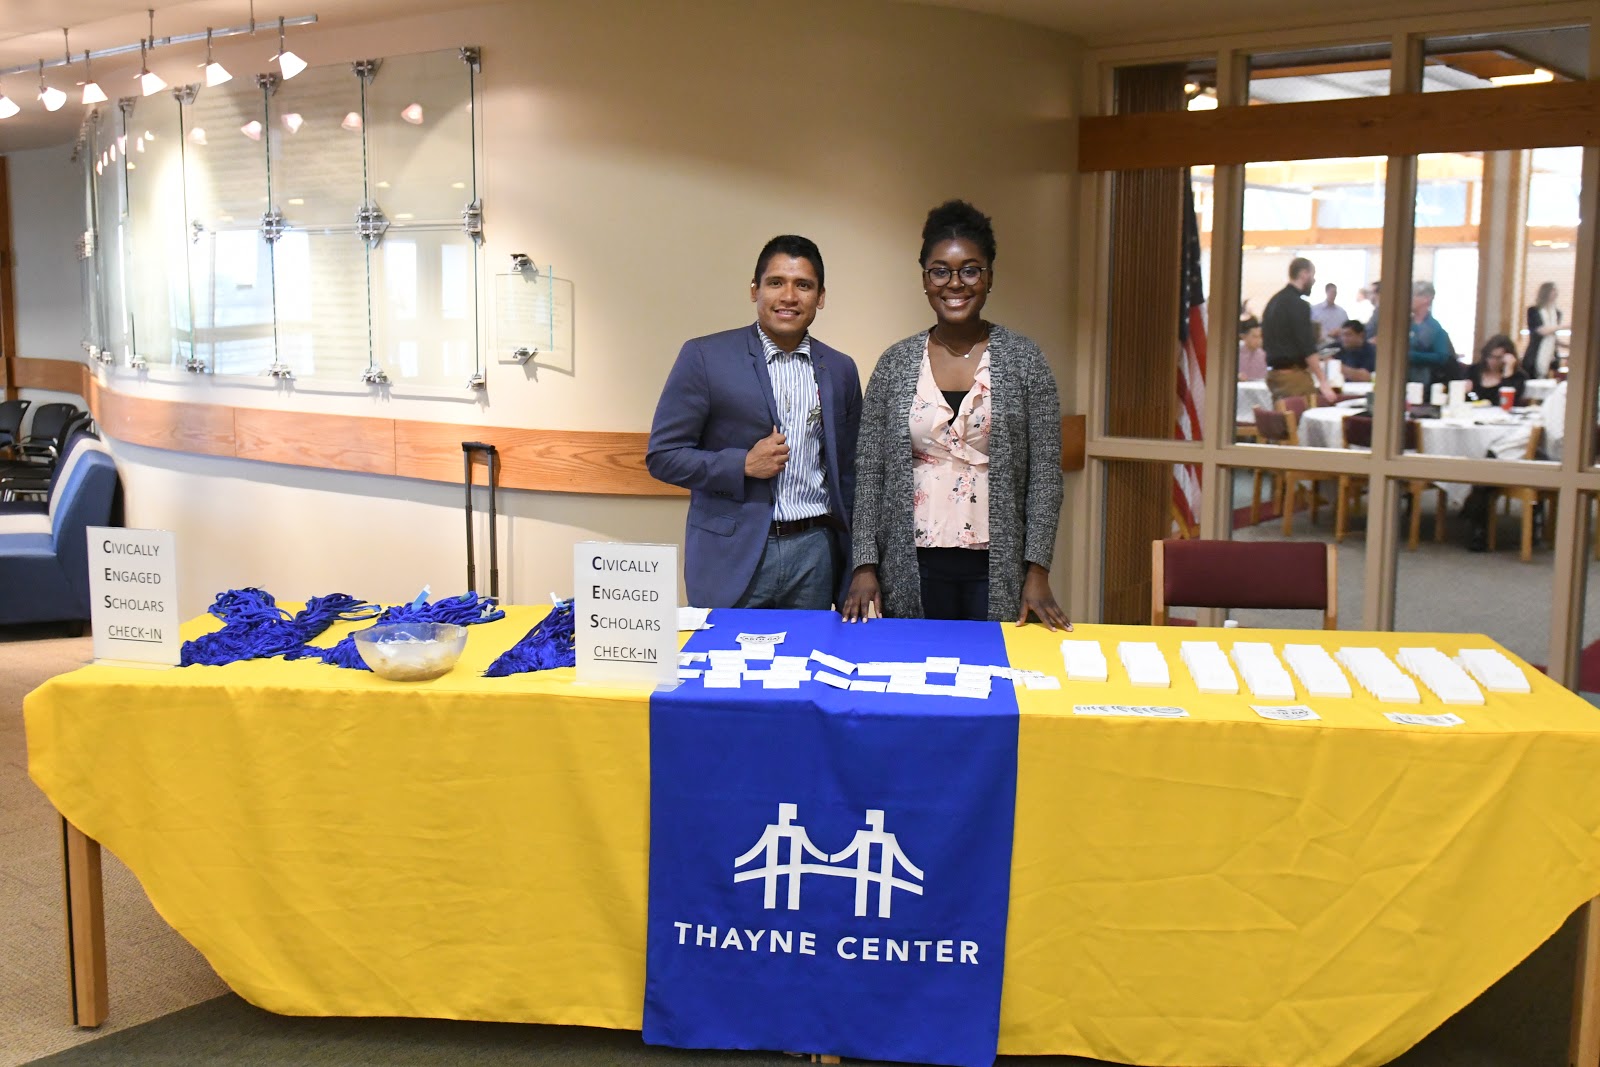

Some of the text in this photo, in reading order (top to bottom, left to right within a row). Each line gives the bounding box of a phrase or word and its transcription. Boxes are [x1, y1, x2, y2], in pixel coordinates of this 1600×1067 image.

[103, 540, 160, 556] CIVICALLY
[592, 556, 659, 573] CIVICALLY
[104, 567, 161, 584] ENGAGED
[592, 585, 659, 602] ENGAGED
[104, 595, 164, 612] SCHOLARS
[590, 614, 661, 632] SCHOLARS
[108, 625, 162, 641] CHECK-IN
[593, 645, 658, 661] CHECK-IN
[673, 921, 980, 965] THAYNE CENTER
